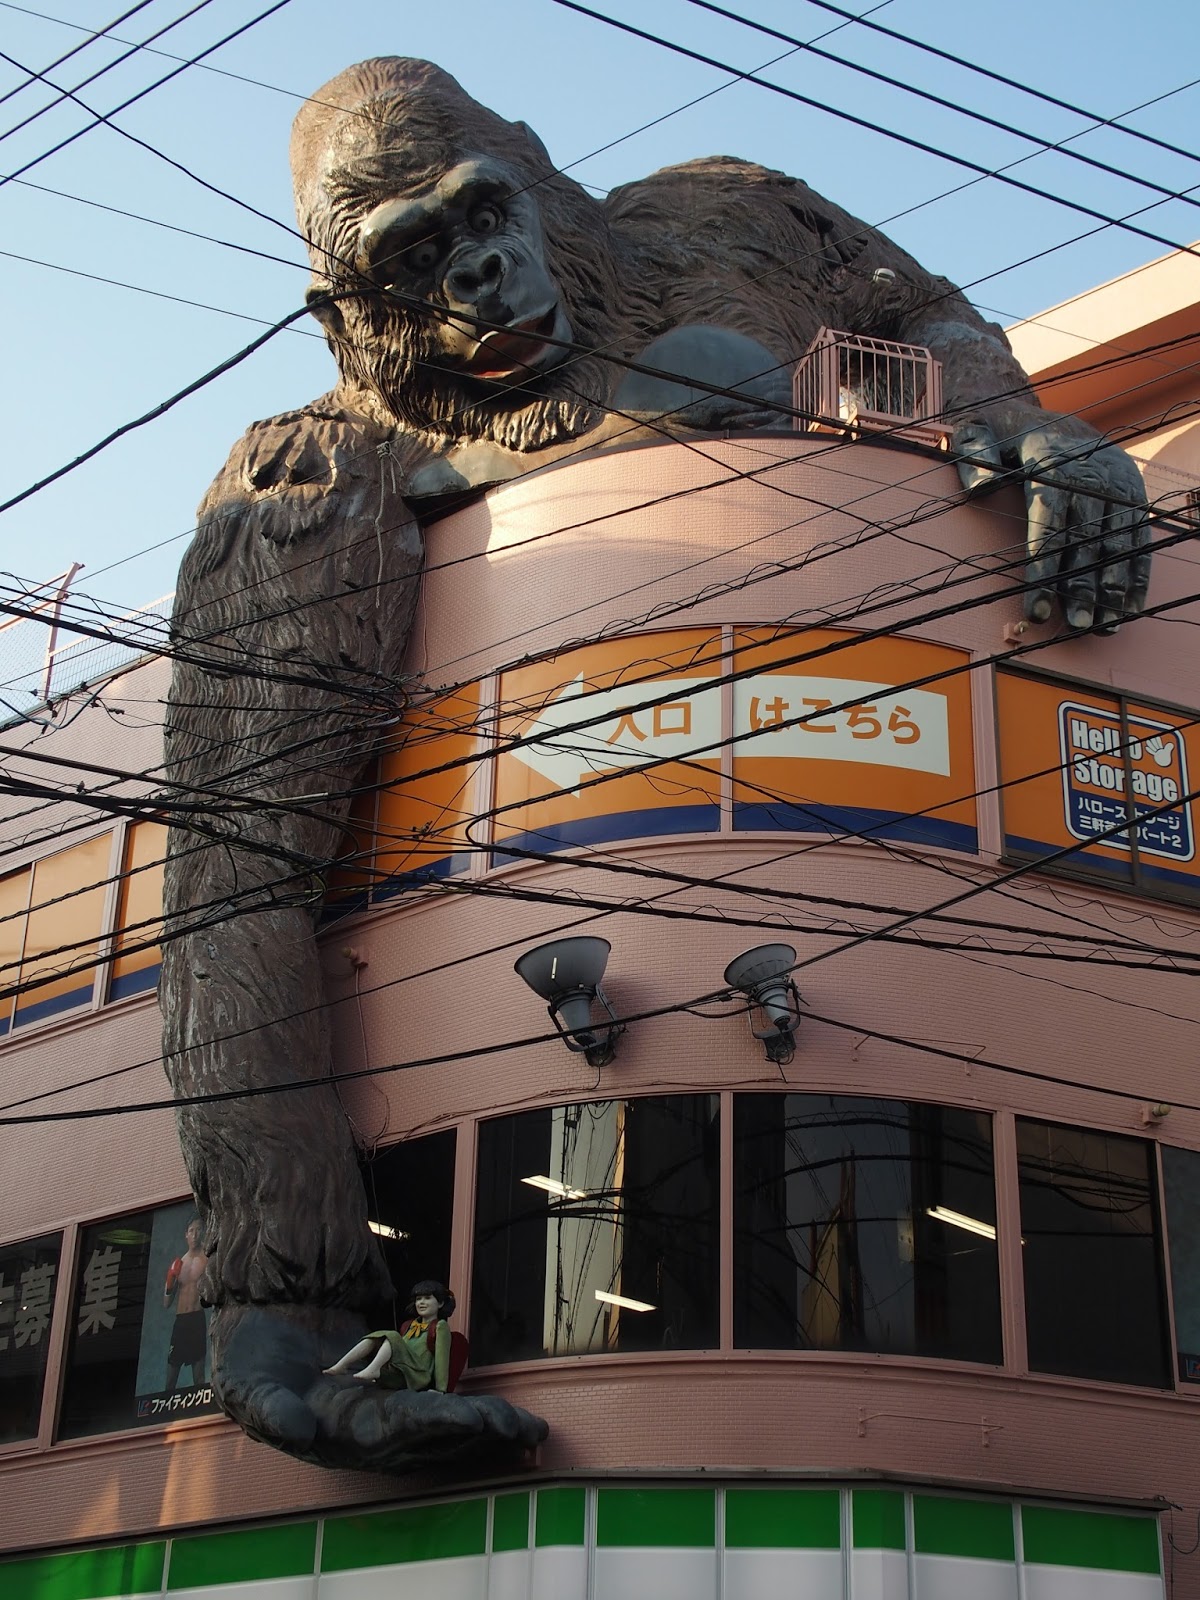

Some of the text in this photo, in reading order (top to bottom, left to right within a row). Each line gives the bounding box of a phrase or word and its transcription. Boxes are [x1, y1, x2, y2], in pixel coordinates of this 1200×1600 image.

[606, 697, 921, 746] 入口 はこちら
[1070, 718, 1143, 761] Hello
[1073, 753, 1179, 802] Storage
[151, 1388, 215, 1413] ファイティングロ
